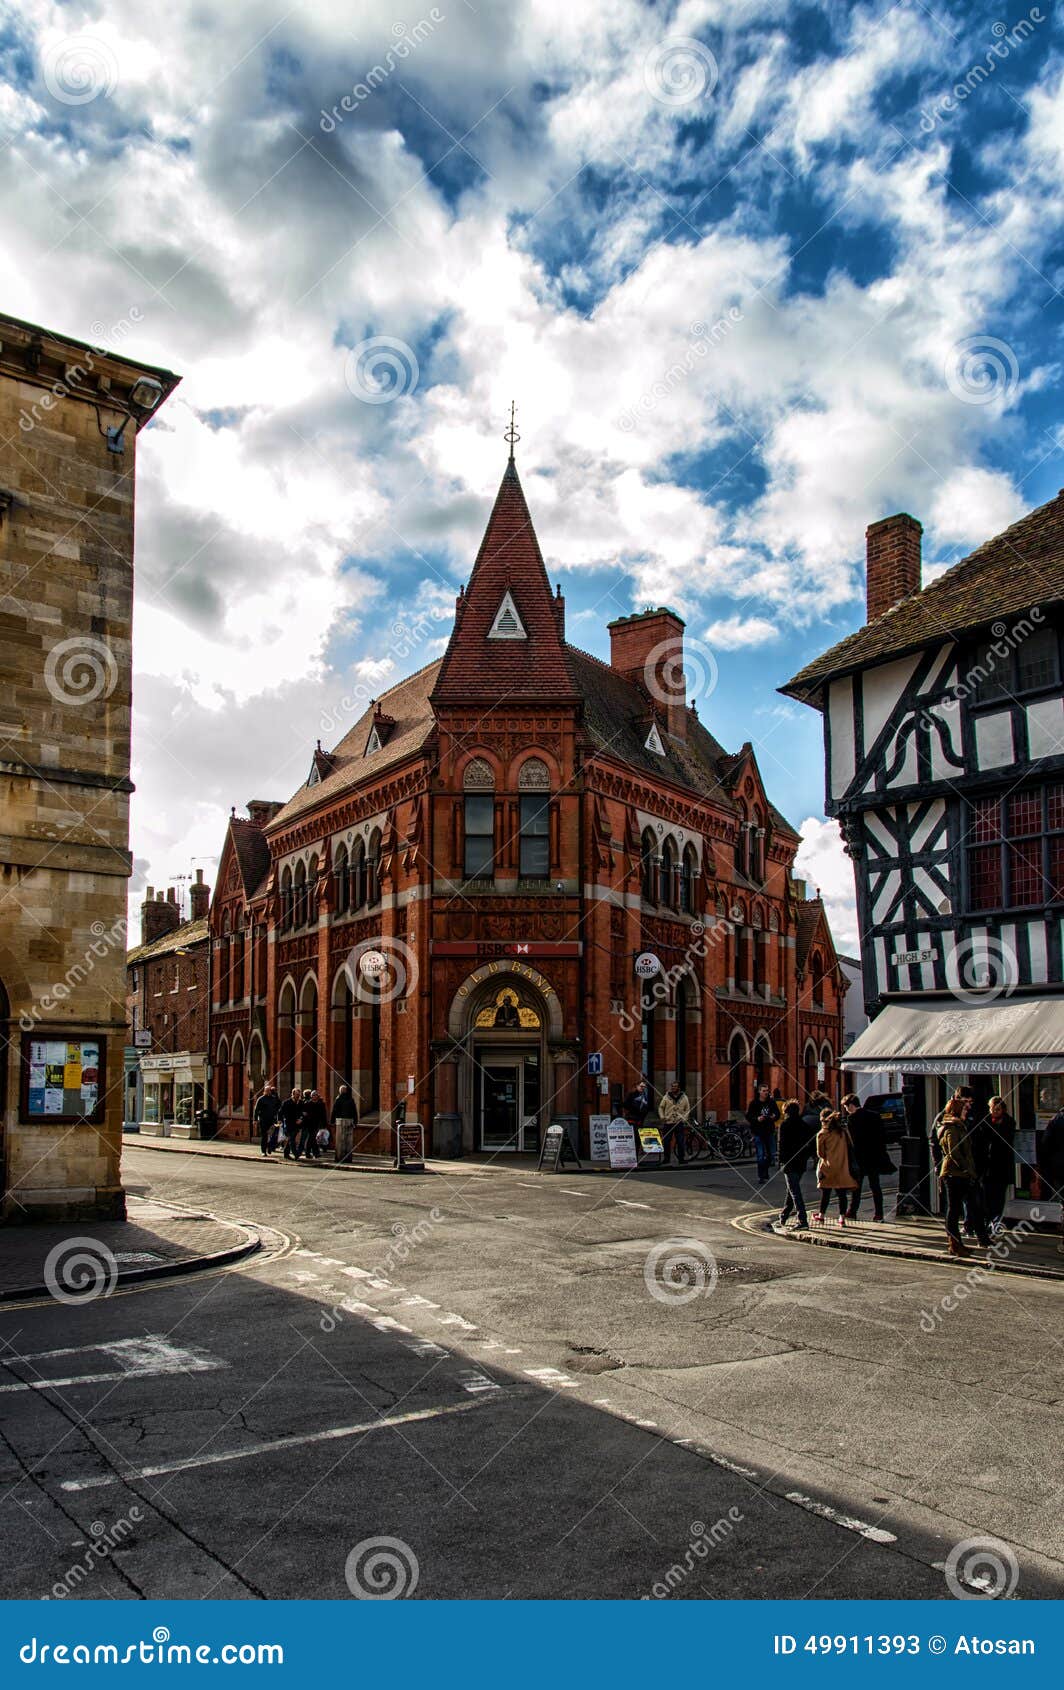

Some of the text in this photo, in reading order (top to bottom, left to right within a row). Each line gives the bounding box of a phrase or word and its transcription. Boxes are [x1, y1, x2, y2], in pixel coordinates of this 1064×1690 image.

[477, 943, 511, 957] HSBC
[897, 950, 932, 963] HIGH ST
[637, 965, 657, 974] HSBC
[458, 961, 556, 998] OLD BANK
[902, 1063, 932, 1072] TAPAS
[943, 1062, 970, 1073] THAI
[970, 1061, 1042, 1072] RESTAURANT
